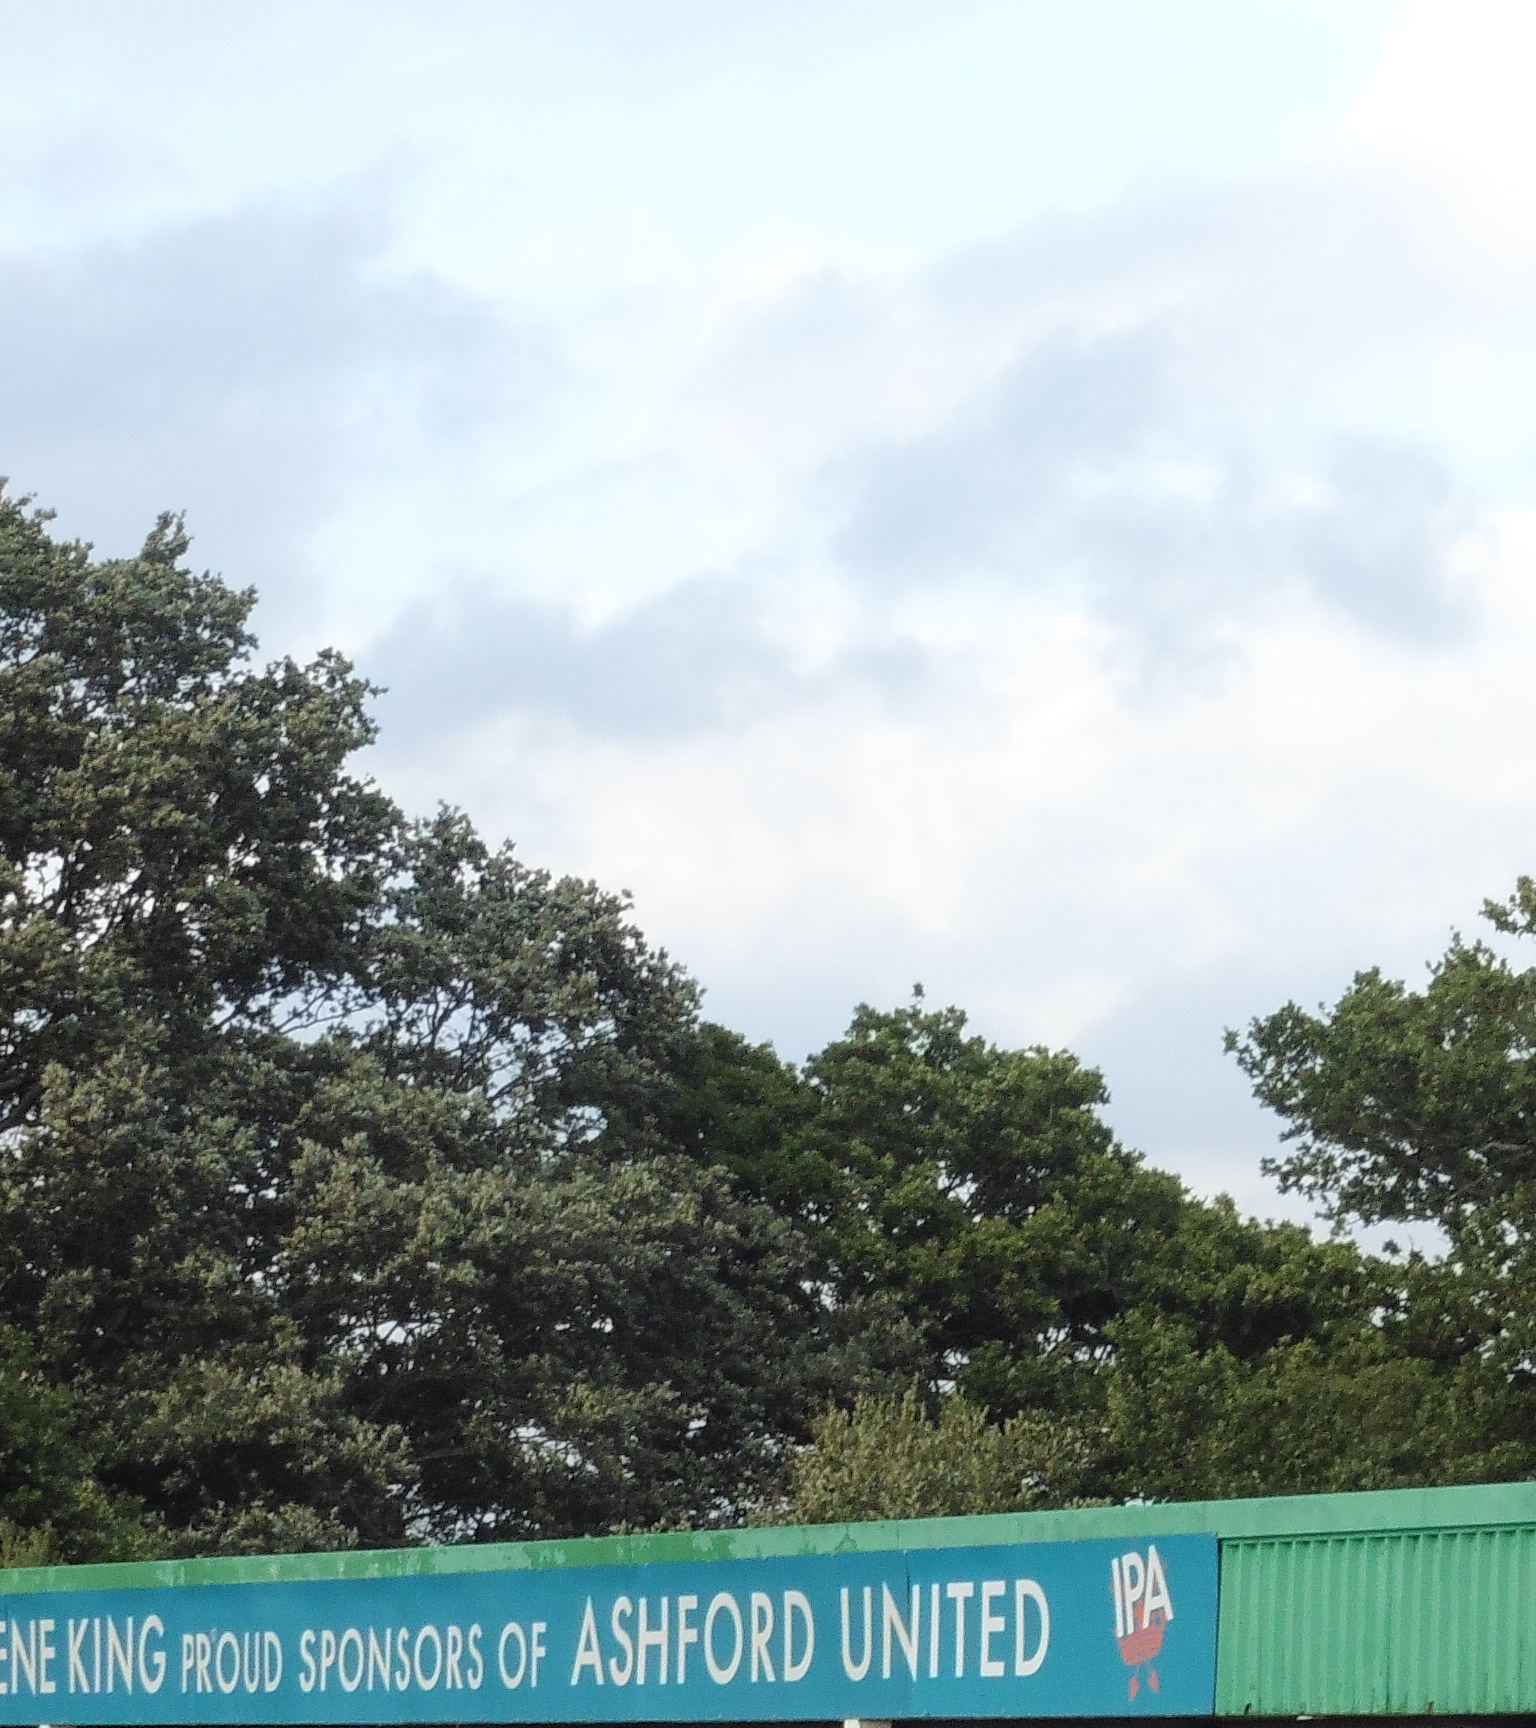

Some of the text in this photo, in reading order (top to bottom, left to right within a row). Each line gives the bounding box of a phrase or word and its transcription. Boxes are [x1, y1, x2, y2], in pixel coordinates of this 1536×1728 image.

[68, 1614, 165, 1693] KING
[181, 1629, 283, 1694] PROUD
[299, 1623, 484, 1693] SPONSORS
[498, 1621, 547, 1689] OF
[571, 1590, 815, 1686] ASHFORD
[839, 1578, 1050, 1681] UNITED
[1111, 1543, 1175, 1638] IPA
